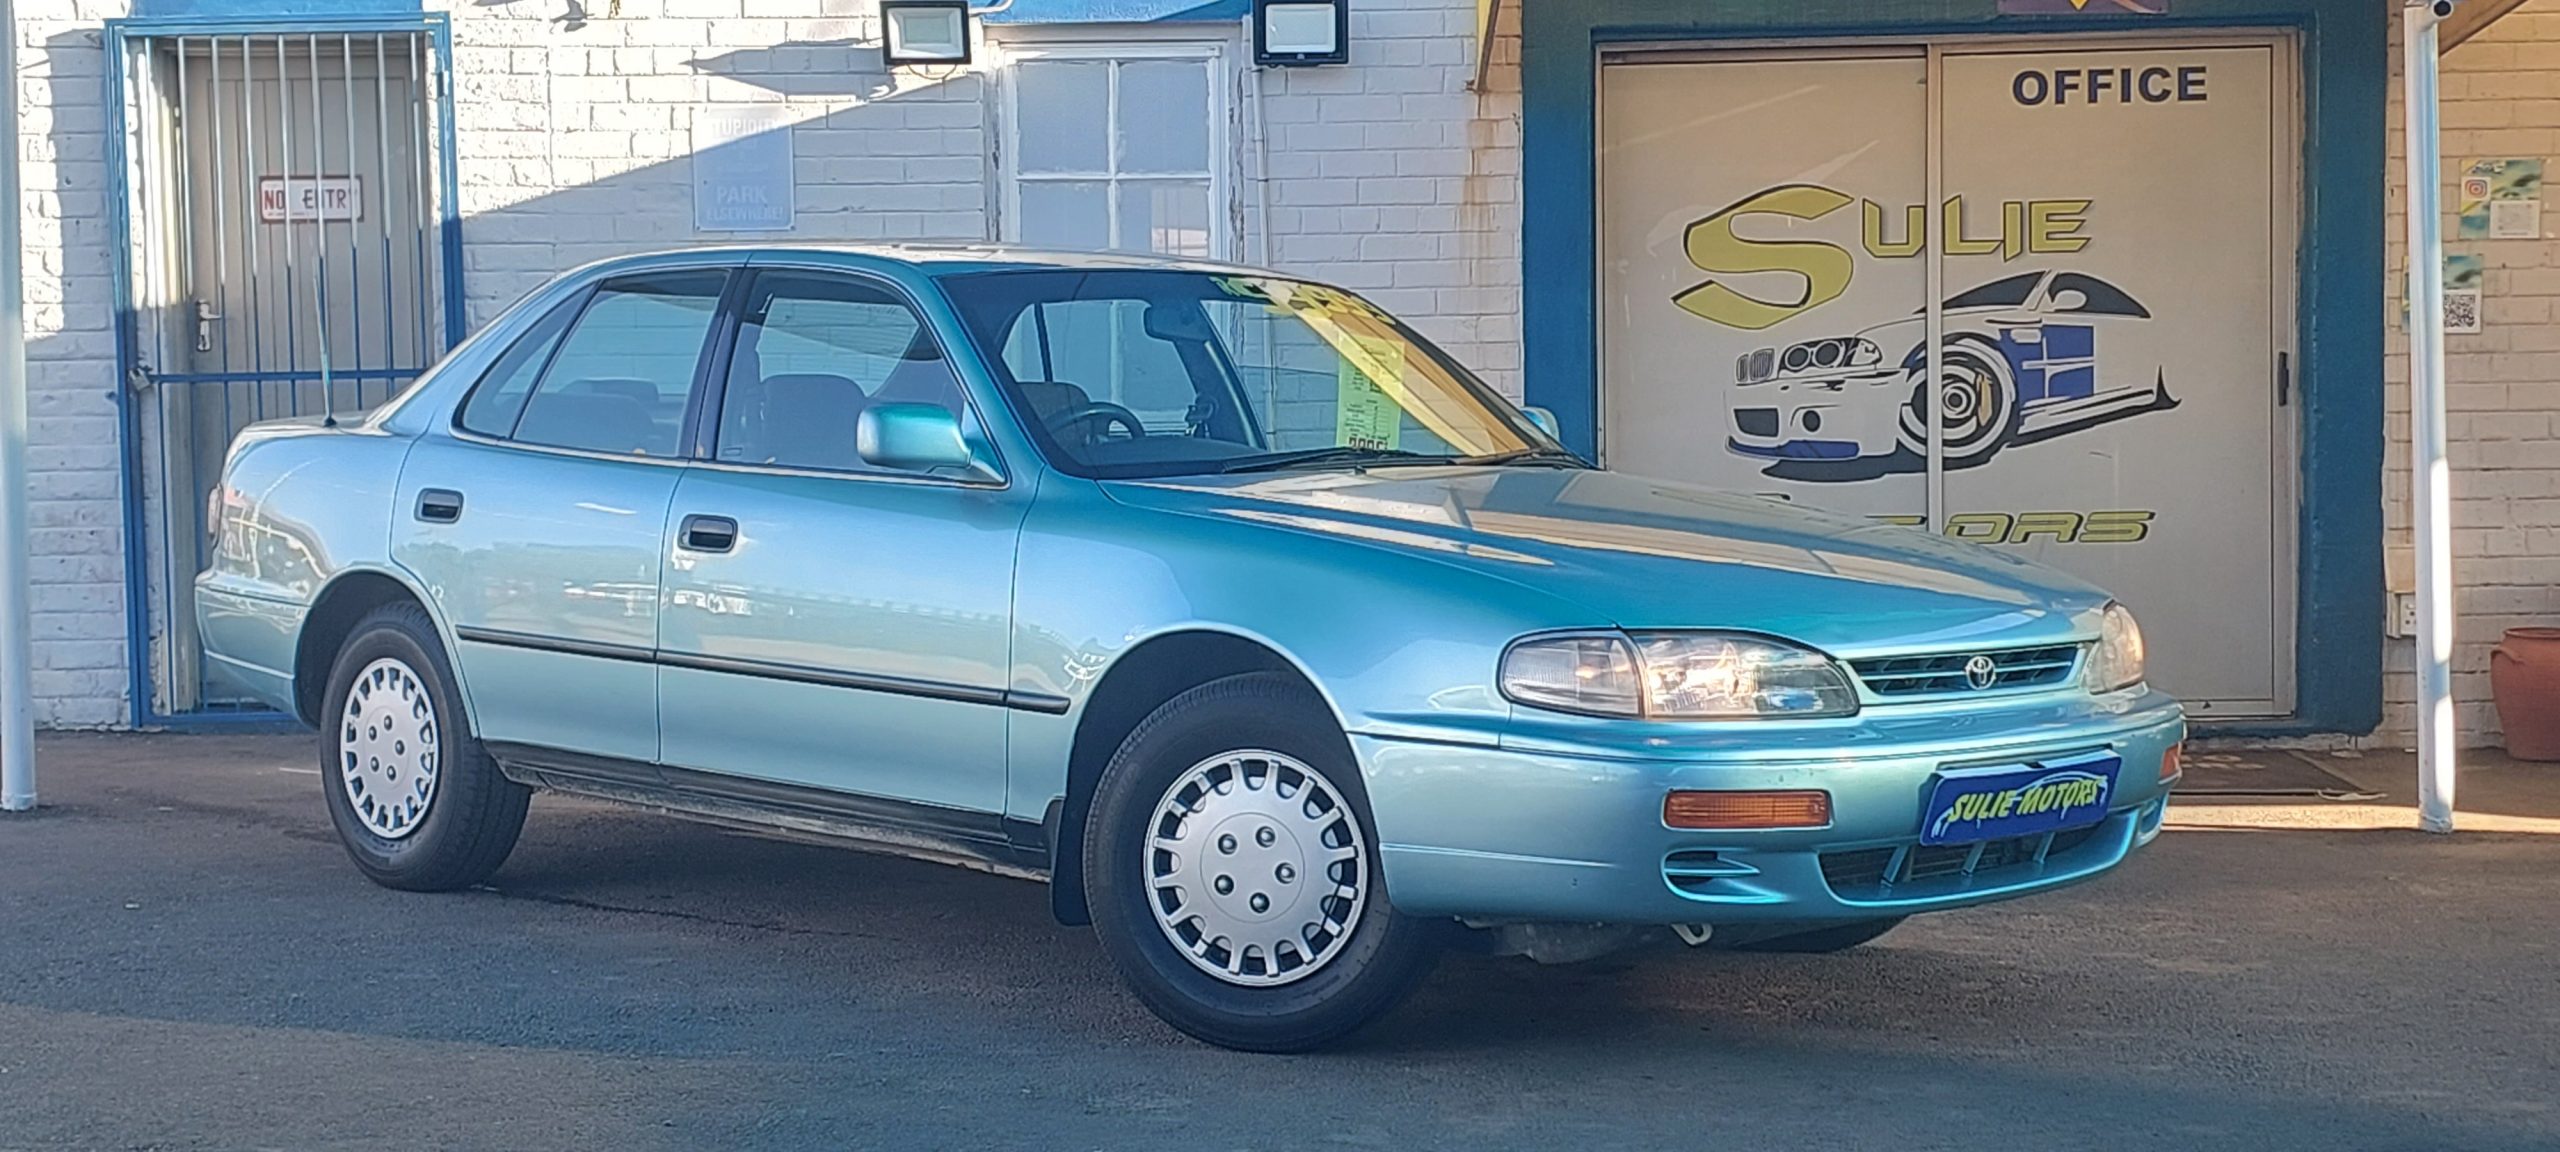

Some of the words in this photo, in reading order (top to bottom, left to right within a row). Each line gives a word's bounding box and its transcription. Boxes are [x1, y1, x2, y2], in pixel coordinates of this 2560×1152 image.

[2012, 65, 2208, 106] OFFICE
[264, 189, 286, 210] NO
[716, 185, 768, 204] PARK
[1670, 183, 2093, 330] SULIE
[1947, 789, 2017, 823] SULIE
[2016, 775, 2108, 816] MOTORS
